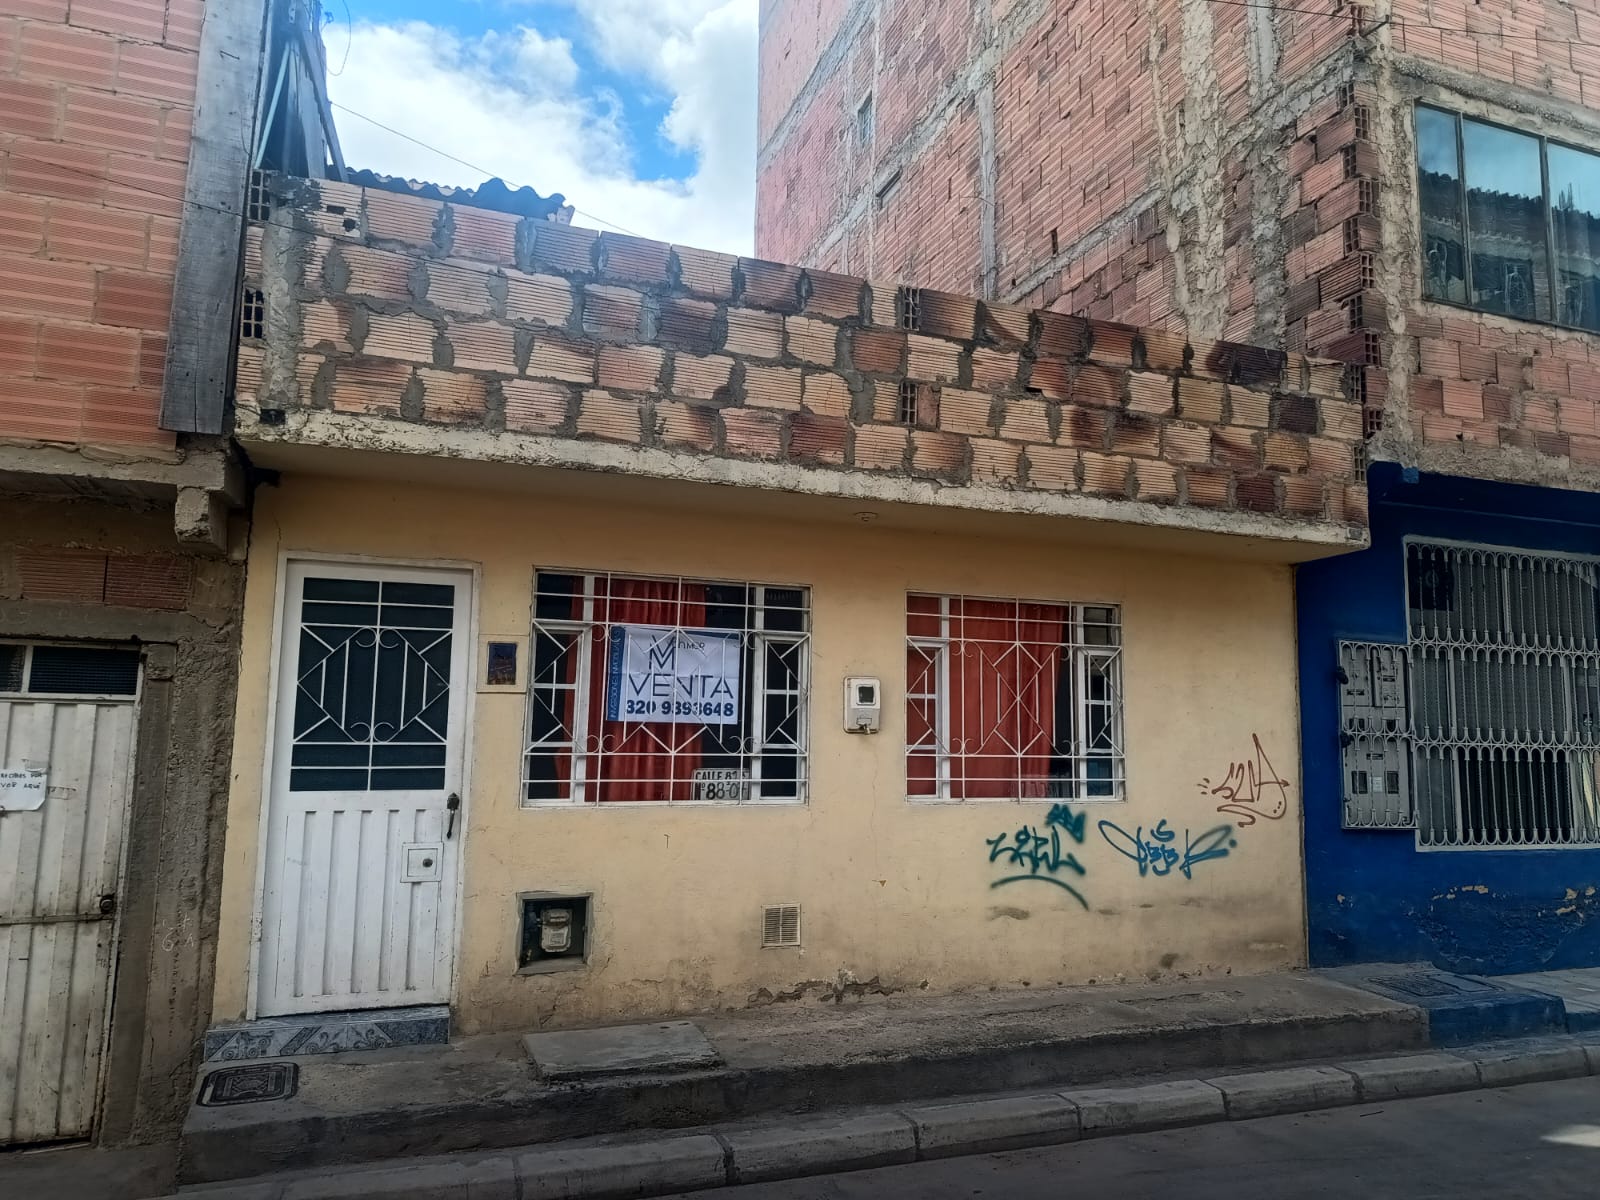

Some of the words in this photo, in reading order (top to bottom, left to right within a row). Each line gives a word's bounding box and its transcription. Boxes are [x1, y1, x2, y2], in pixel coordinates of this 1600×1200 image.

[628, 673, 734, 699] VENTA
[626, 699, 657, 715] 320
[695, 771, 723, 780] CALLE
